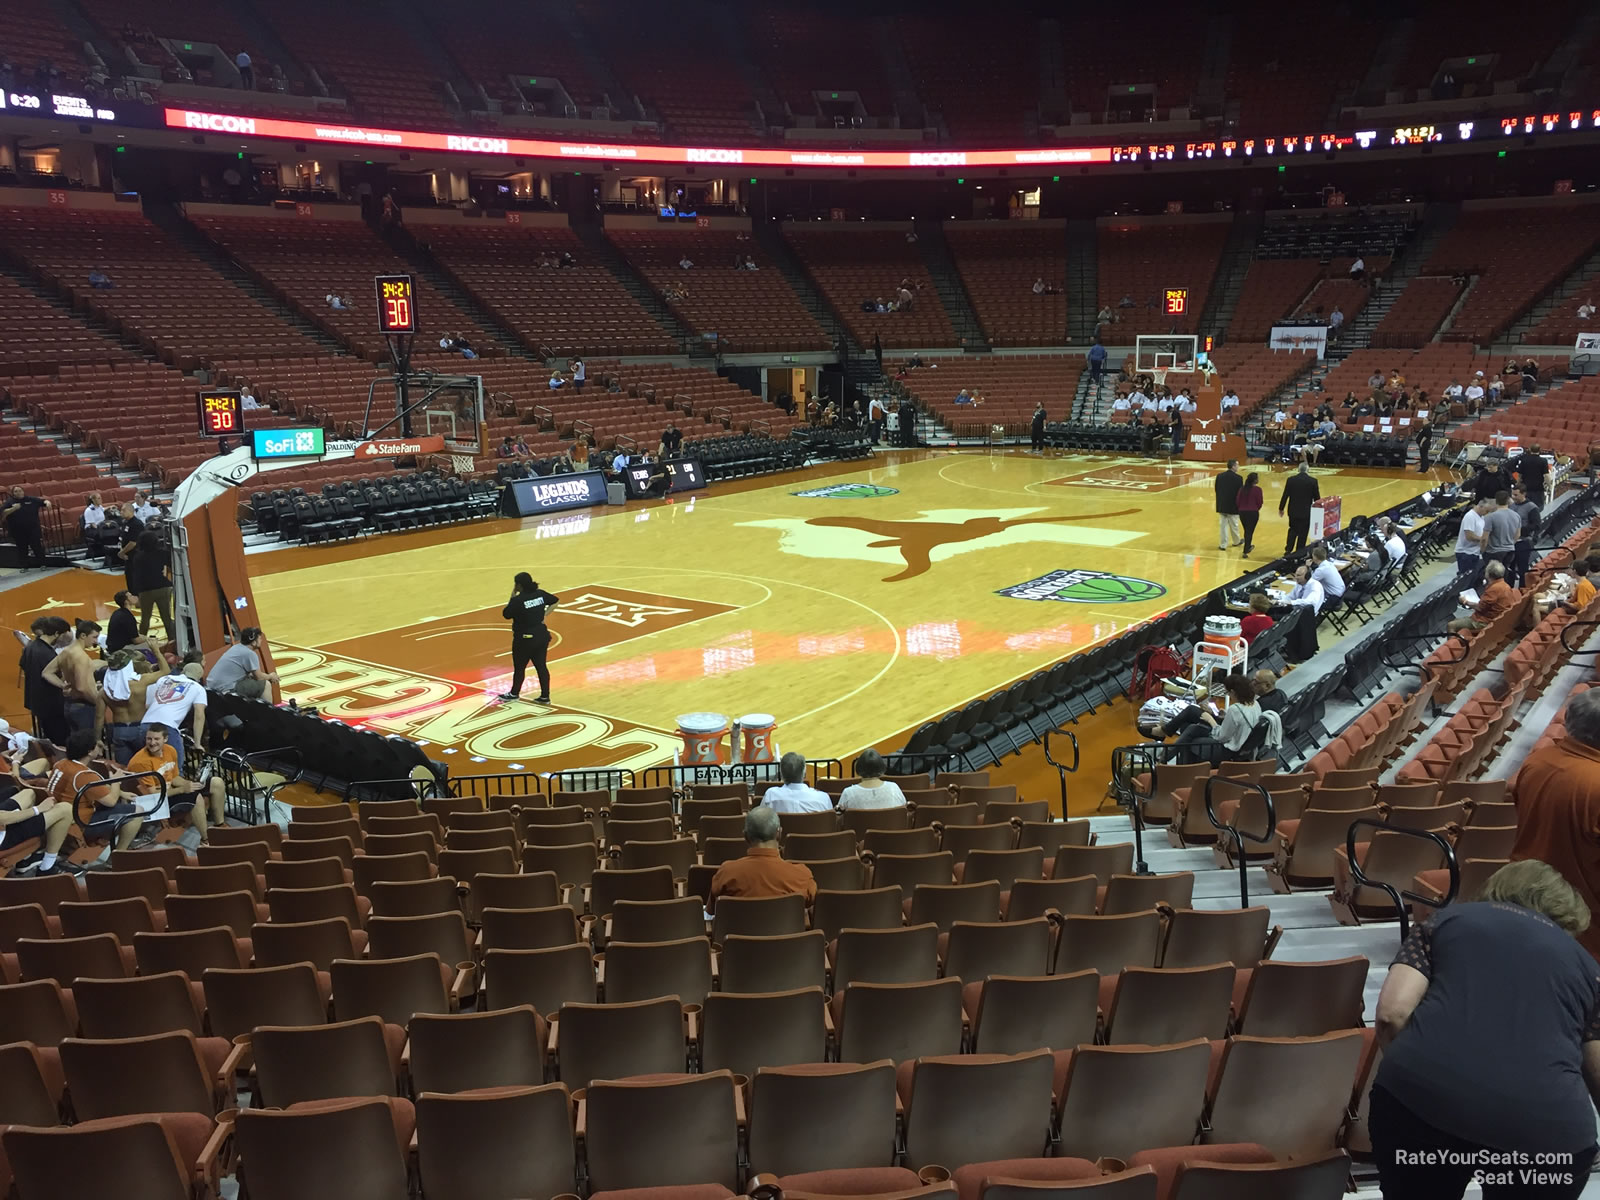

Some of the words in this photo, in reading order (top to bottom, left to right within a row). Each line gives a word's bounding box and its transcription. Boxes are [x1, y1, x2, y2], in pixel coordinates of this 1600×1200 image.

[185, 111, 255, 133] RICOH
[1395, 126, 1434, 138] 34:21
[448, 135, 507, 153] RICOH
[687, 149, 743, 163] RICOH
[50, 192, 65, 204] 35
[298, 206, 311, 216] 34
[508, 214, 520, 223] 33
[698, 218, 709, 227] 32
[383, 282, 410, 298] 34:21
[1166, 290, 1187, 299] 34:21
[1168, 298, 1184, 313] 30
[387, 299, 409, 326] 30
[204, 397, 236, 411] 34:21
[211, 412, 232, 429] 30
[1191, 434, 1217, 443] MUSCLE
[265, 439, 295, 453] SoFi
[327, 443, 357, 452] PALDING
[1195, 442, 1212, 451] MILK
[532, 480, 590, 502] LEGENDS
[541, 494, 589, 506] CLASSIC
[524, 596, 545, 609] SECURITY
[697, 742, 710, 755] G
[753, 736, 765, 748] G
